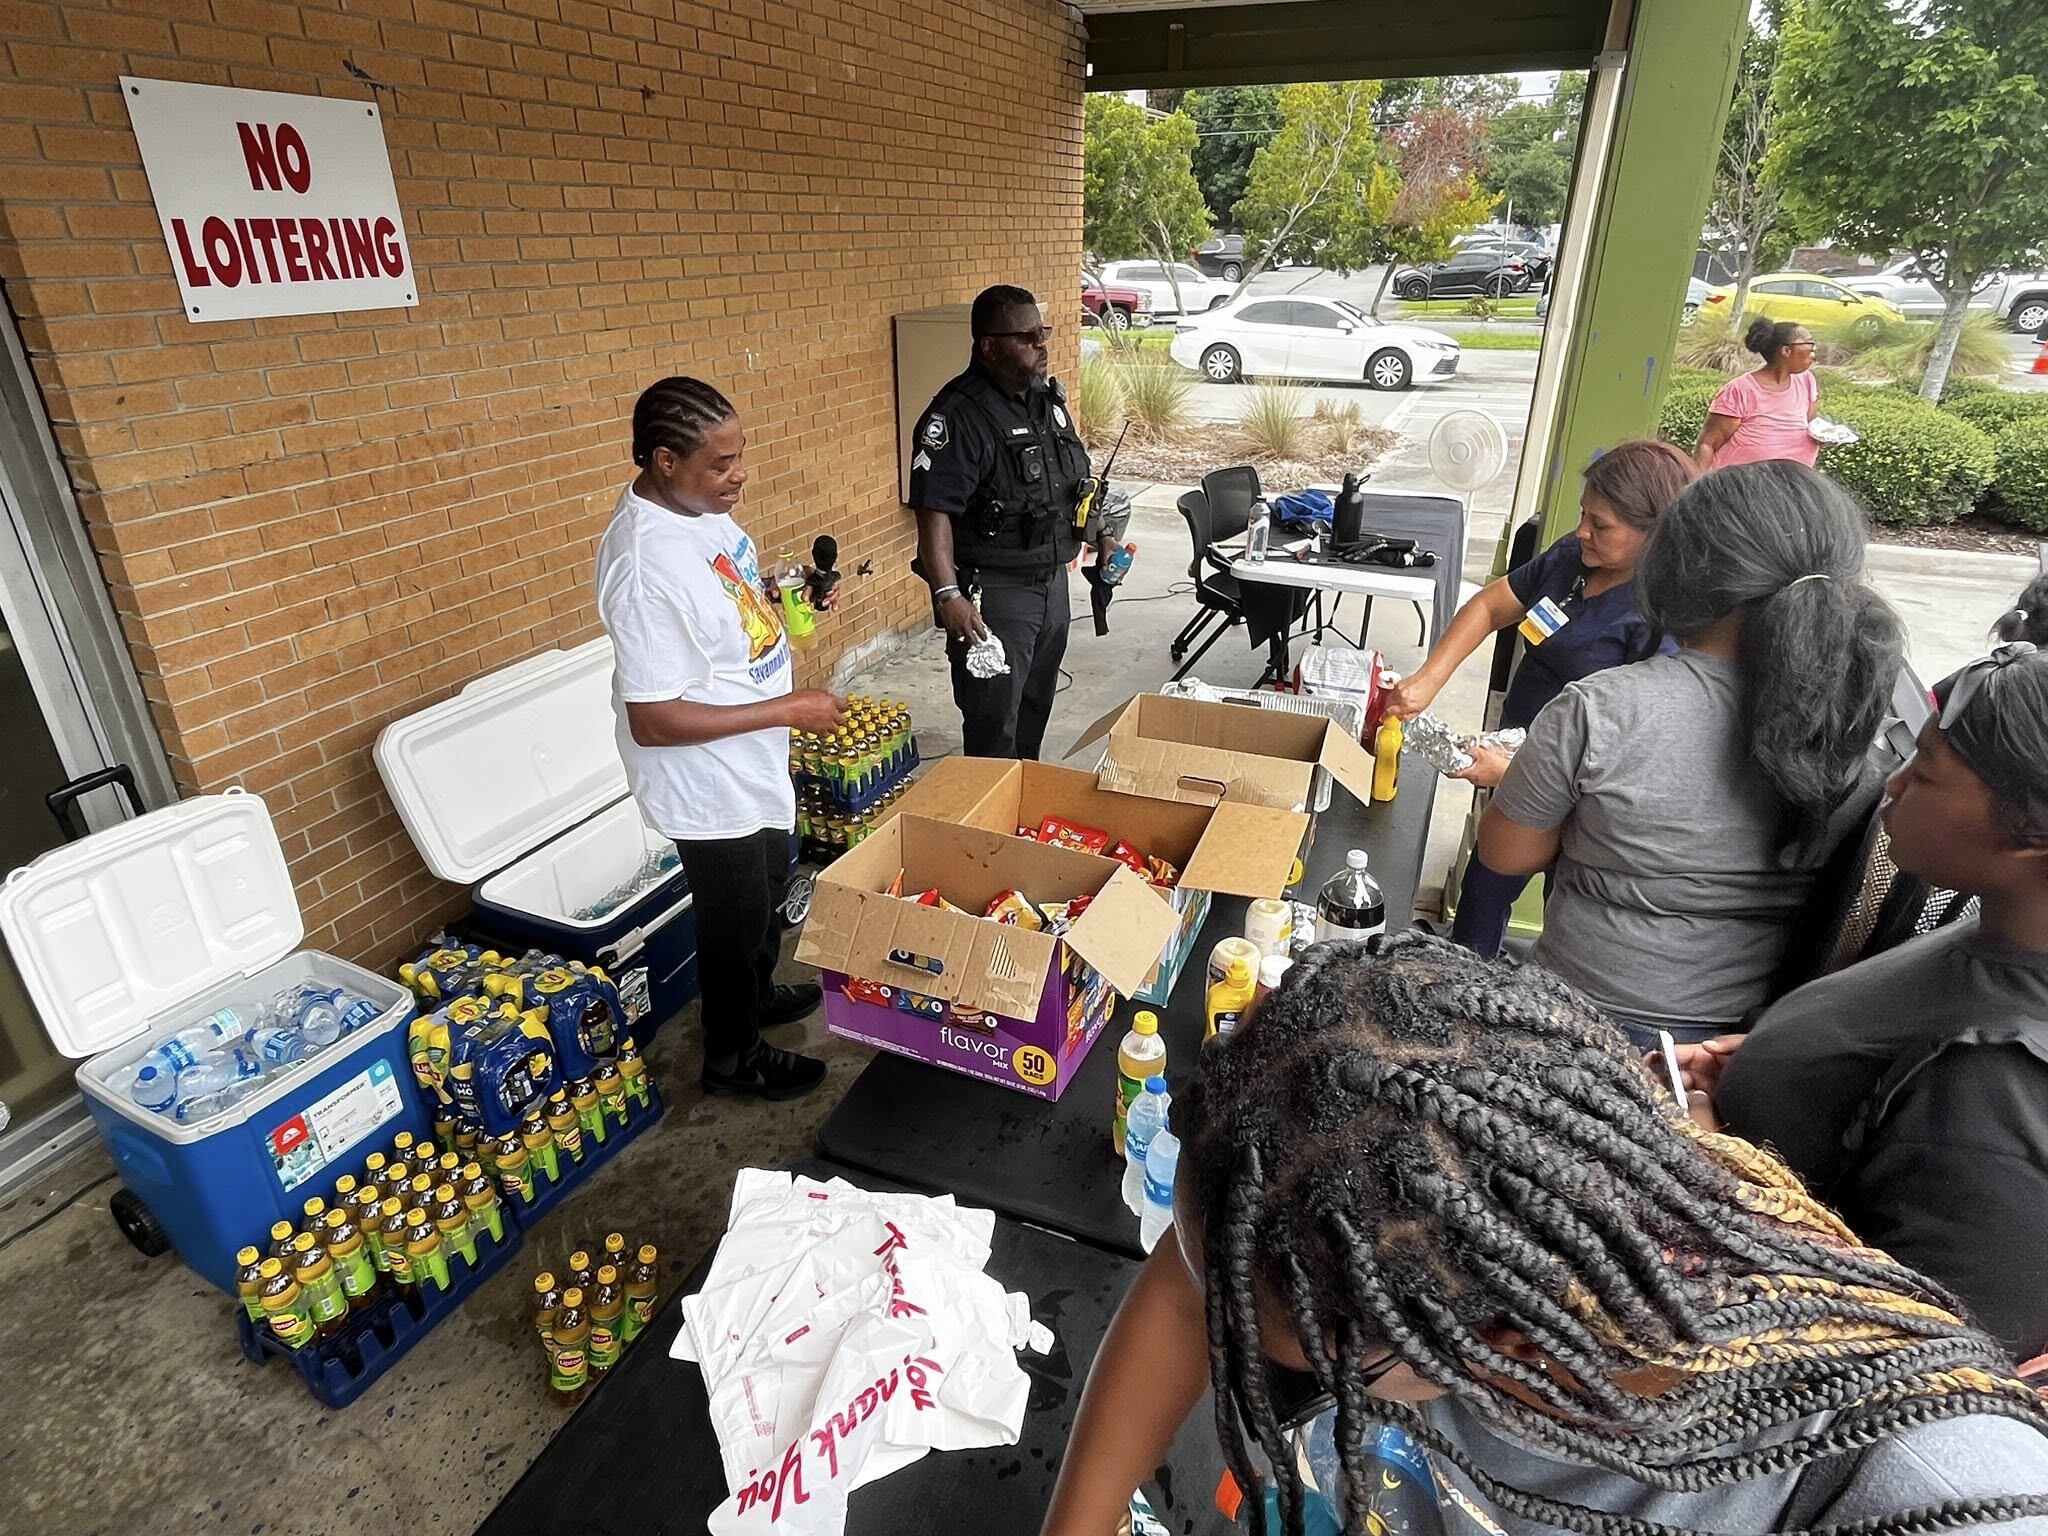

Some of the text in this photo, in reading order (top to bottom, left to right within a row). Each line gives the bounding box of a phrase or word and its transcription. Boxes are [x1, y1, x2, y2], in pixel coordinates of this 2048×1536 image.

[235, 122, 311, 194] NO
[170, 216, 406, 288] LOITERING
[940, 1027, 1009, 1060] flavor
[992, 1060, 1009, 1070] MIX
[1022, 1051, 1045, 1074] 50
[1023, 1070, 1045, 1081] BAGS
